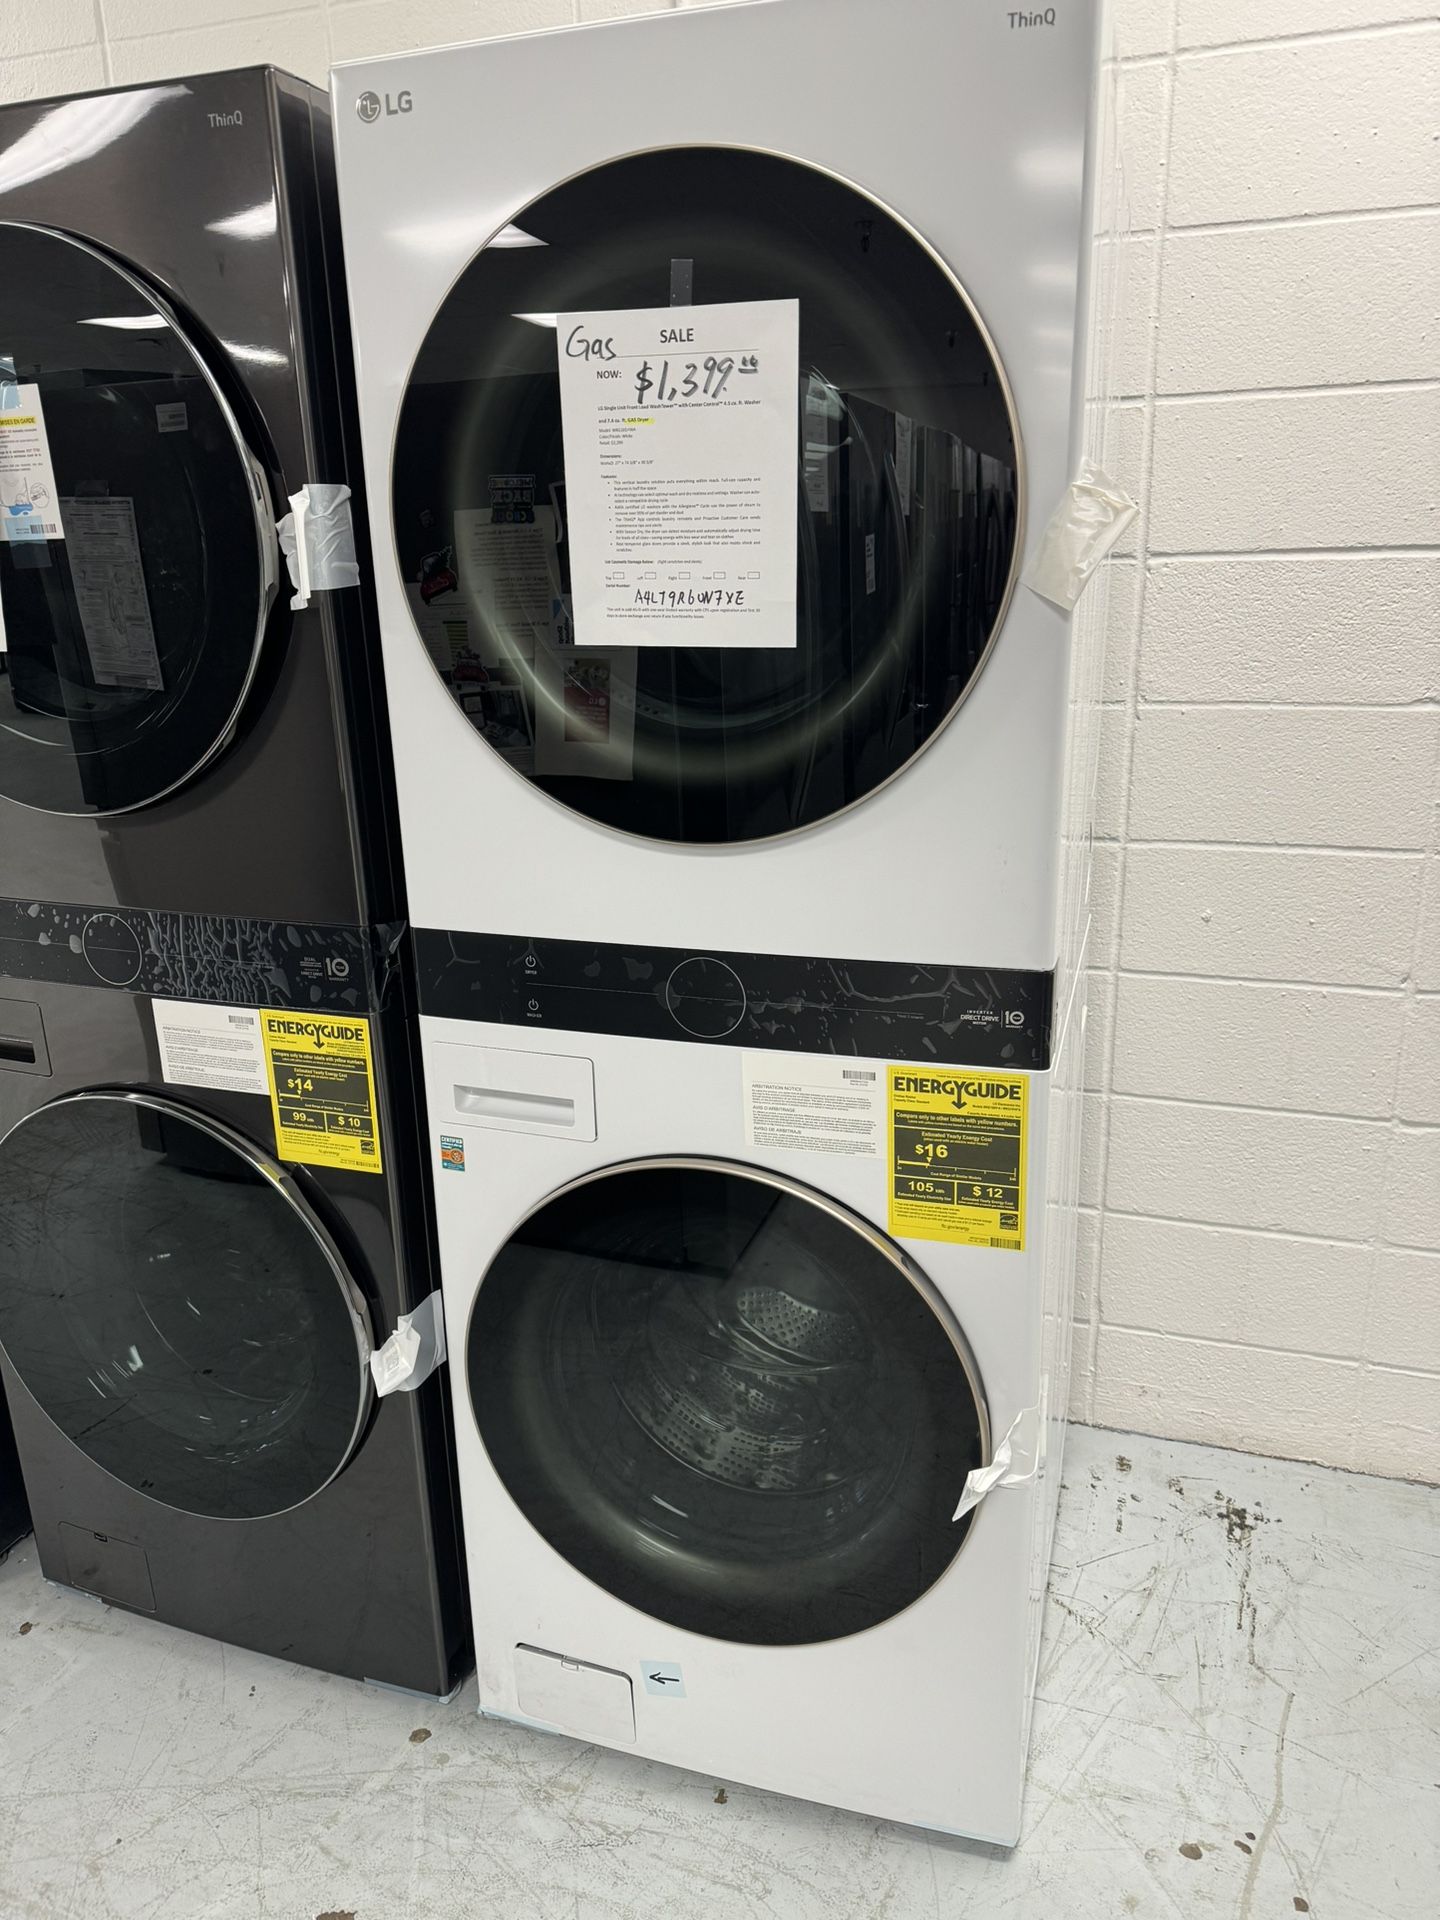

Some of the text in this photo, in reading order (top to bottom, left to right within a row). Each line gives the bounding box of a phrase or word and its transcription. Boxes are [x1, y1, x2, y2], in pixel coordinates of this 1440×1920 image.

[1008, 8, 1055, 29] ThinQ
[386, 90, 413, 115] LG
[208, 110, 242, 128] ThinQ
[566, 325, 617, 361] Gas
[659, 328, 694, 344] SALE
[596, 370, 622, 379] NOW:
[325, 957, 349, 976] 10
[1005, 1011, 1024, 1025] 10
[267, 1019, 364, 1041] ENERGYGUIDE
[334, 1057, 346, 1065] yellow
[287, 1078, 313, 1091] $14
[894, 1076, 1021, 1100] ENERGYGUIDE
[292, 1111, 306, 1121] 99
[338, 1117, 360, 1127] $ 10
[896, 1112, 917, 1120] Compare
[977, 1118, 993, 1126] yellow
[921, 1131, 946, 1139] Estimated
[947, 1133, 962, 1141] Yearly
[962, 1135, 980, 1143] Energy
[915, 1143, 948, 1158] $16
[908, 1181, 934, 1193] 105
[973, 1186, 1003, 1198] $ 12
